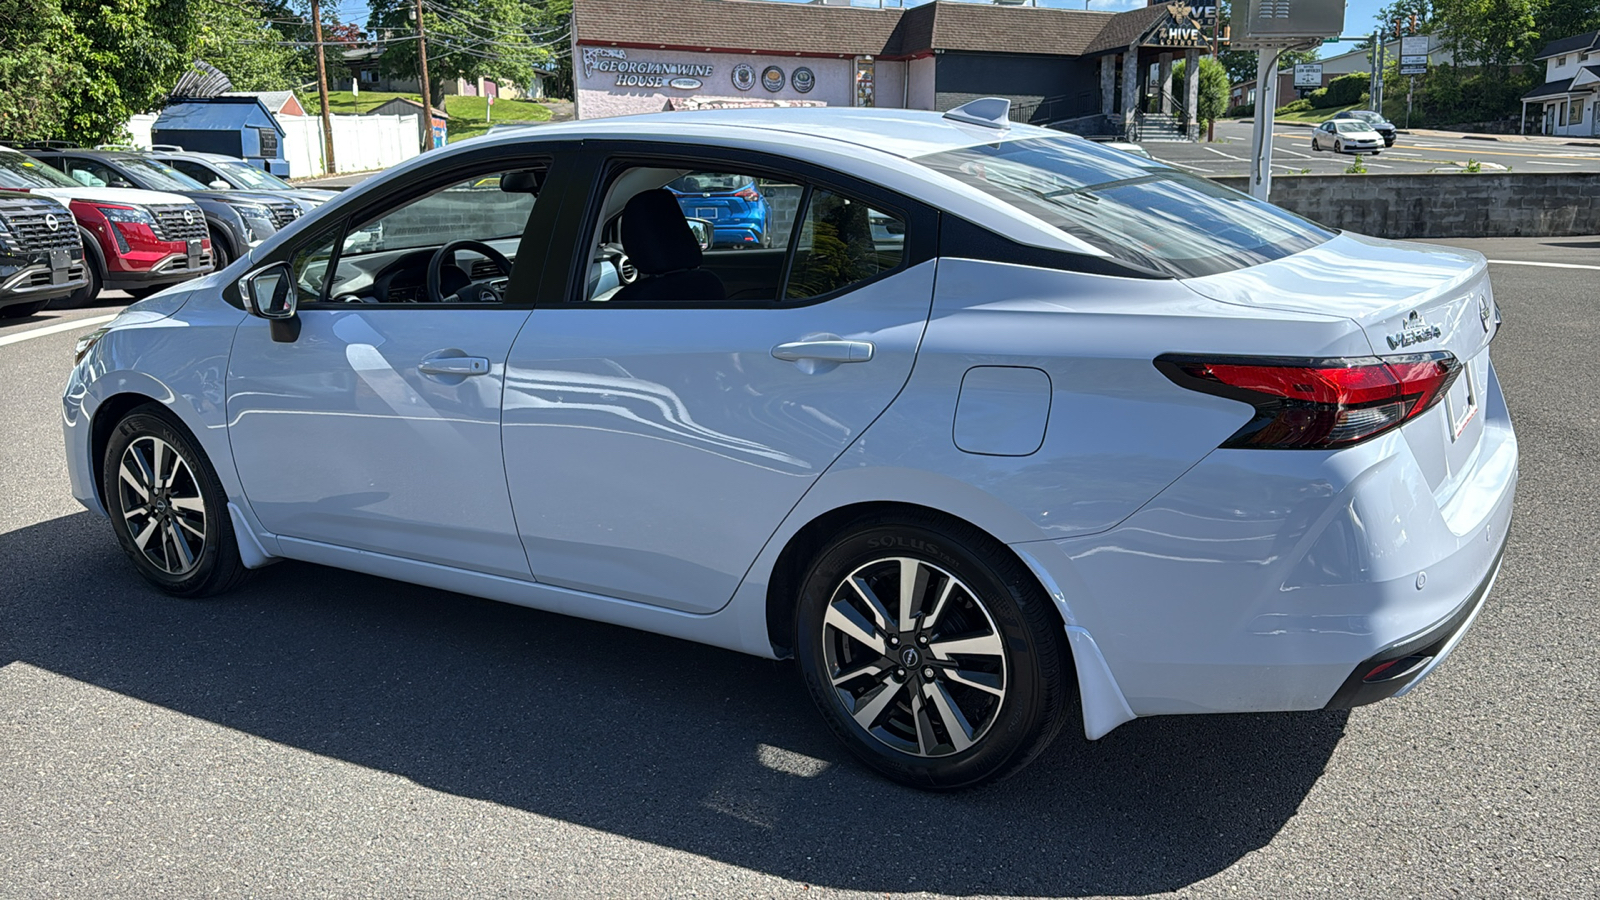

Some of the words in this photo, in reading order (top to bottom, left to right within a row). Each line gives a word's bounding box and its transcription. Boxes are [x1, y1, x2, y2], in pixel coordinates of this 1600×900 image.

[1169, 27, 1199, 41] HIVE
[599, 60, 674, 74] GEORGIAN
[676, 64, 714, 77] WINE
[615, 74, 663, 87] HOUSE
[1386, 325, 1442, 351] VERSA
[162, 427, 198, 473] KUMHO
[867, 535, 939, 555] SOLUS
